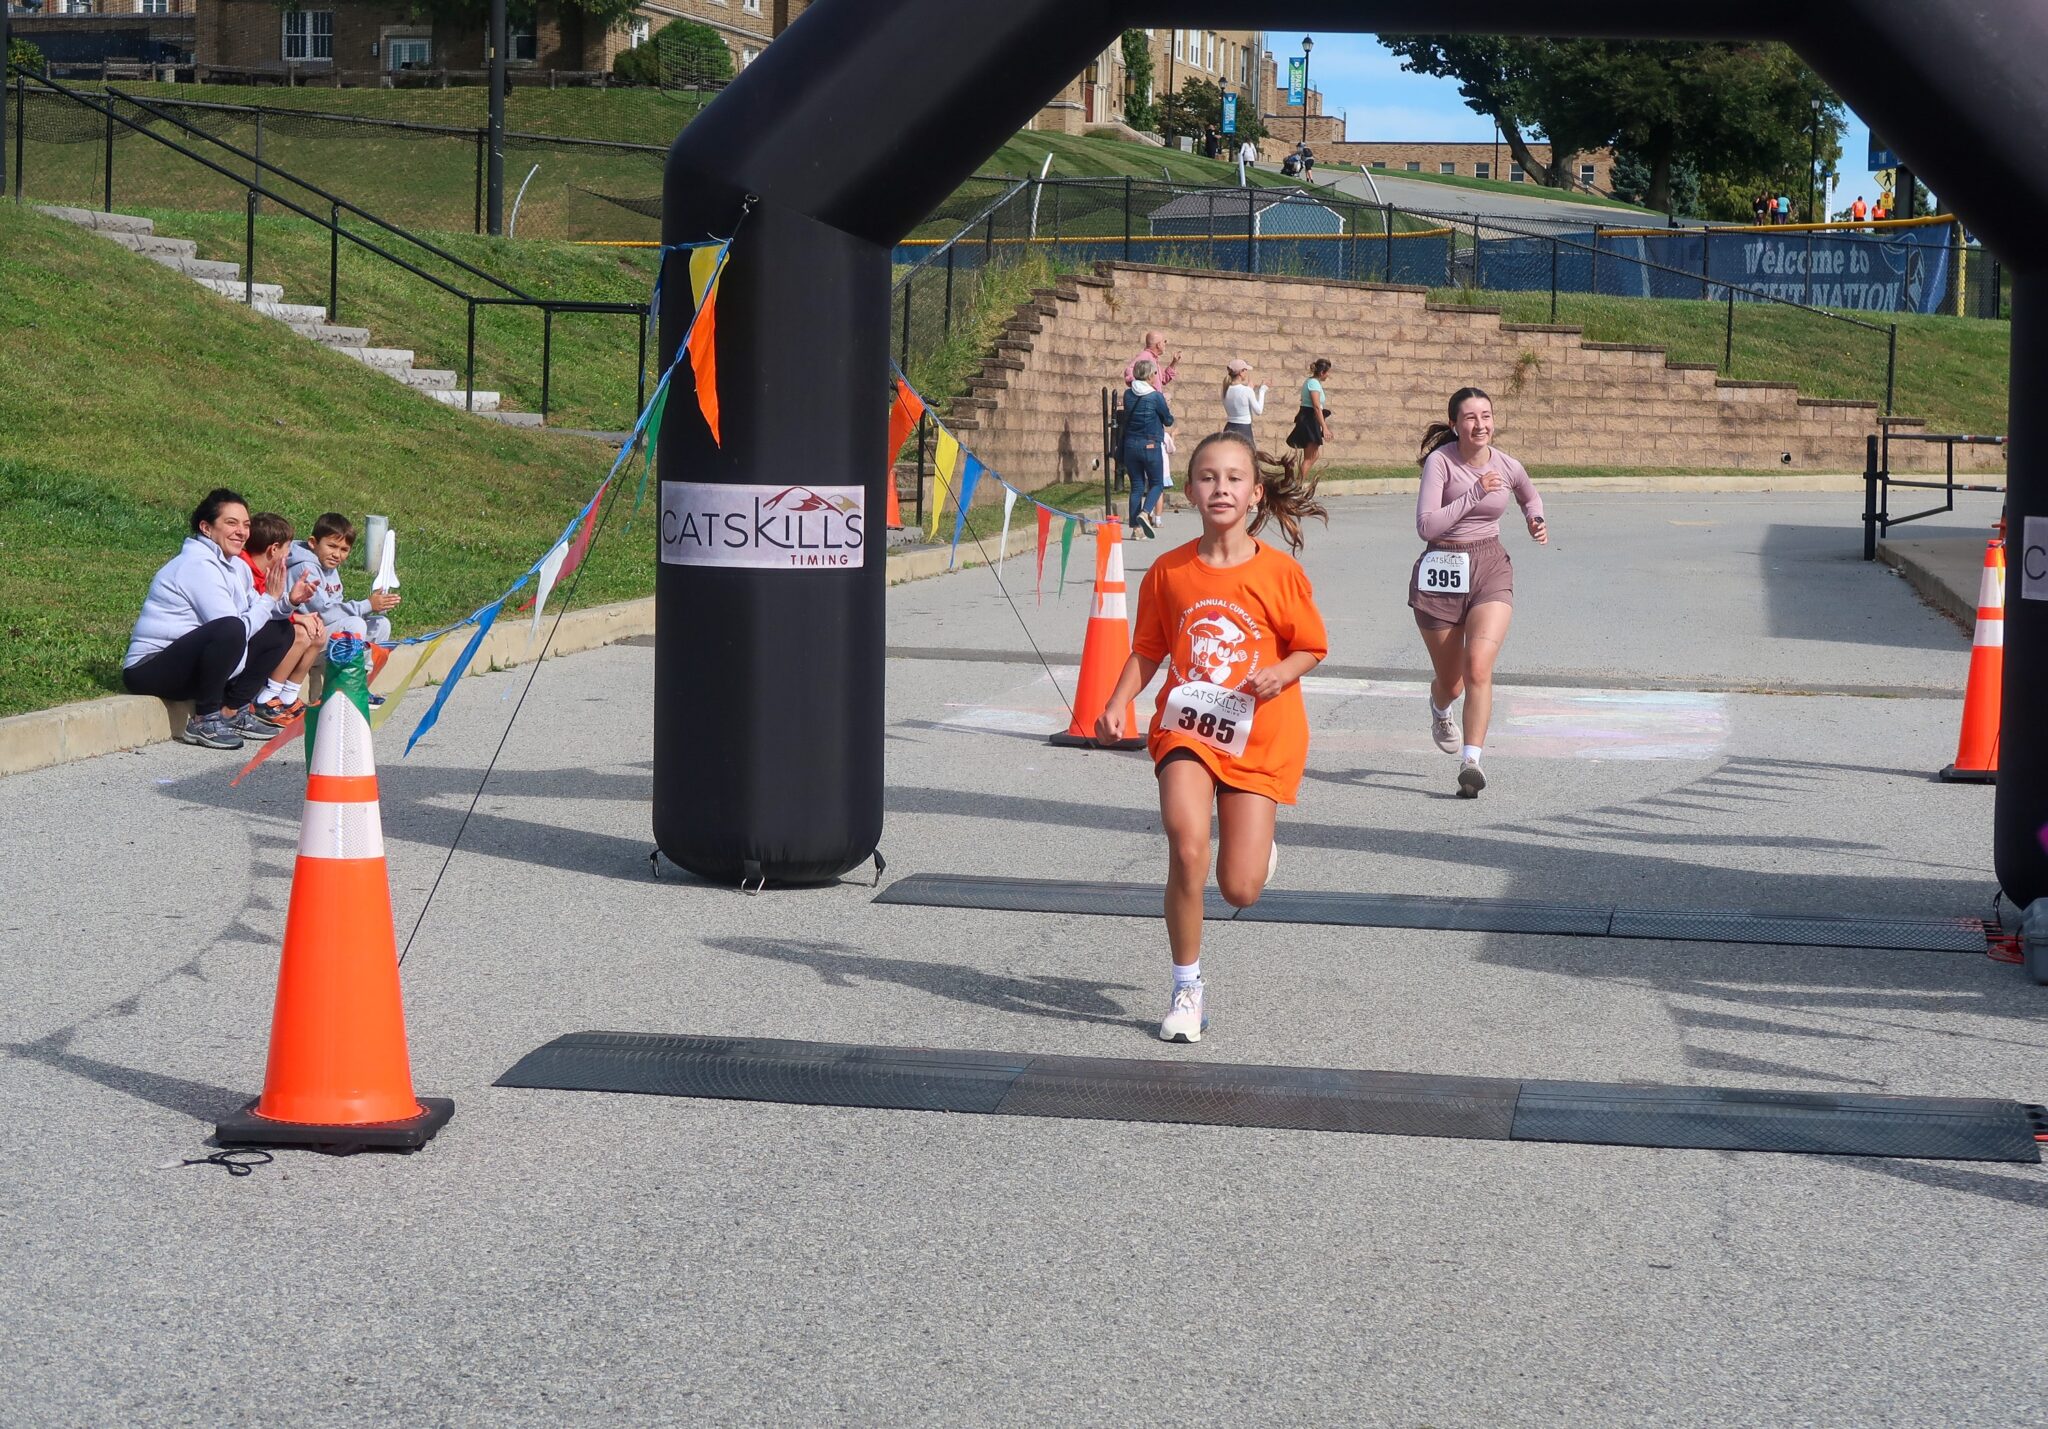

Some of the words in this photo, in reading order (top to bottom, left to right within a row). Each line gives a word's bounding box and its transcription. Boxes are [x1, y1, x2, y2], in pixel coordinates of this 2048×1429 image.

[1744, 238, 1845, 275] Welcome
[1849, 243, 1870, 274] to
[1811, 281, 1900, 312] NATION
[661, 496, 863, 549] CATSKILLS
[790, 554, 849, 566] TIMING
[1427, 568, 1461, 588] 395
[1195, 598, 1228, 610] ANNUAL
[1229, 603, 1258, 632] CUPCAKE
[1181, 686, 1247, 714] CATSKILLS
[1178, 706, 1236, 744] 385
